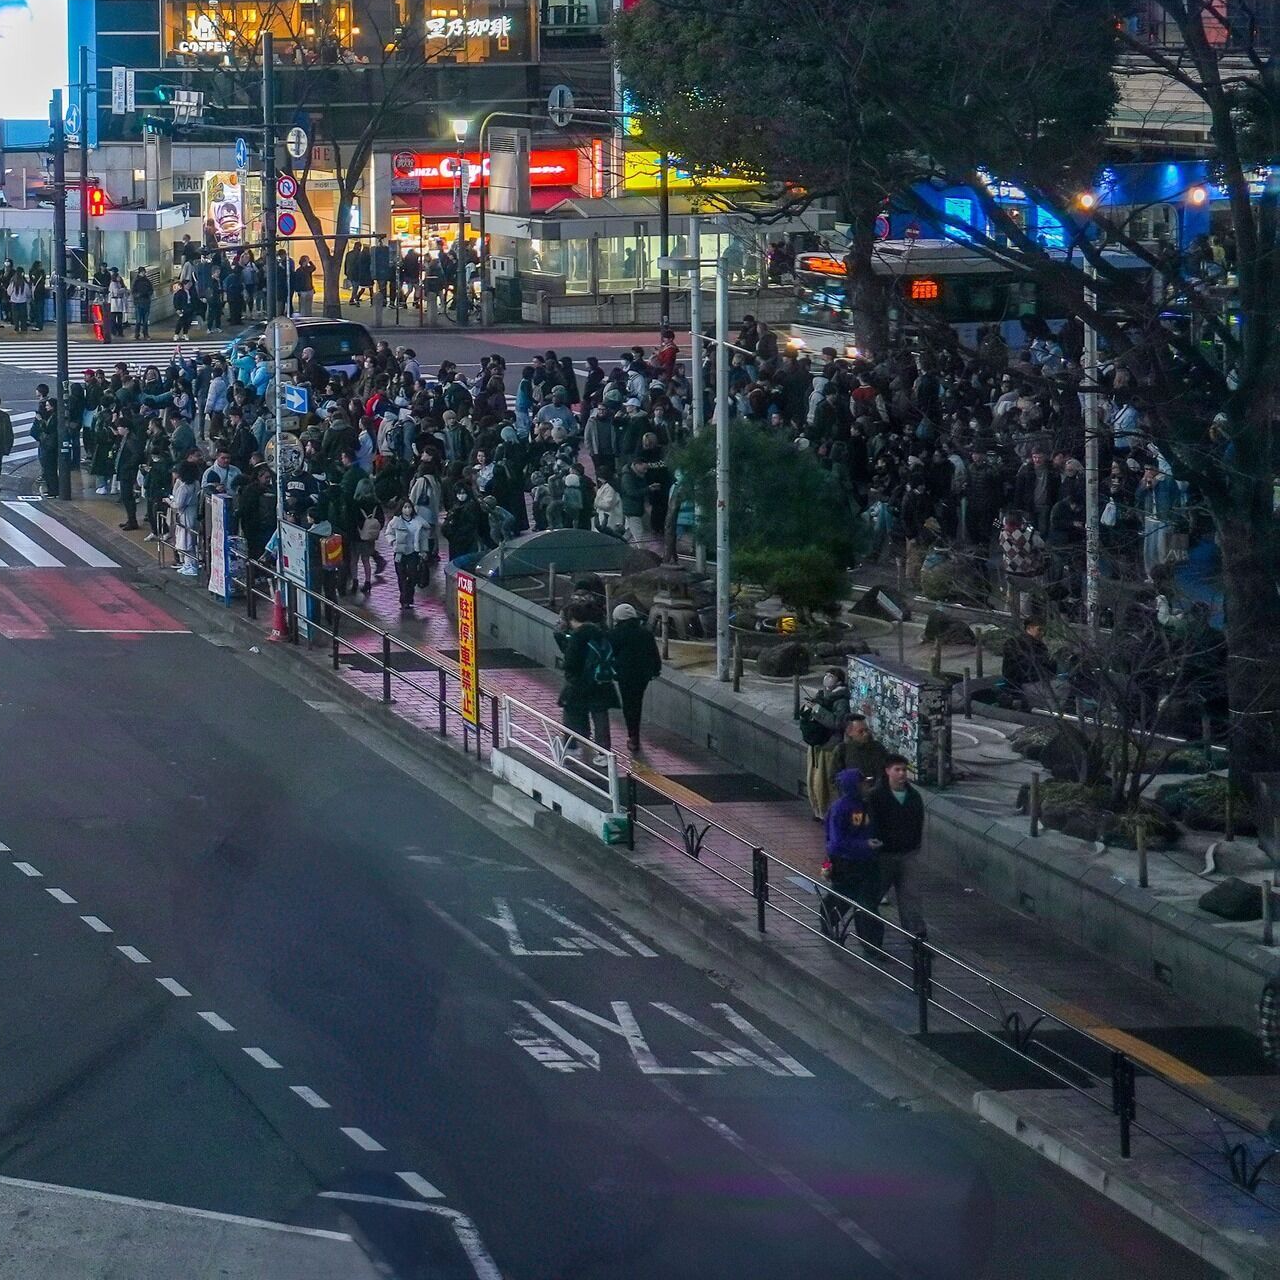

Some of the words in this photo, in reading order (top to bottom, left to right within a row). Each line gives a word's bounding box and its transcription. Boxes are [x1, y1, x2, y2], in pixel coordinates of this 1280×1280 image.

[459, 597, 473, 716] 駐停車禁止
